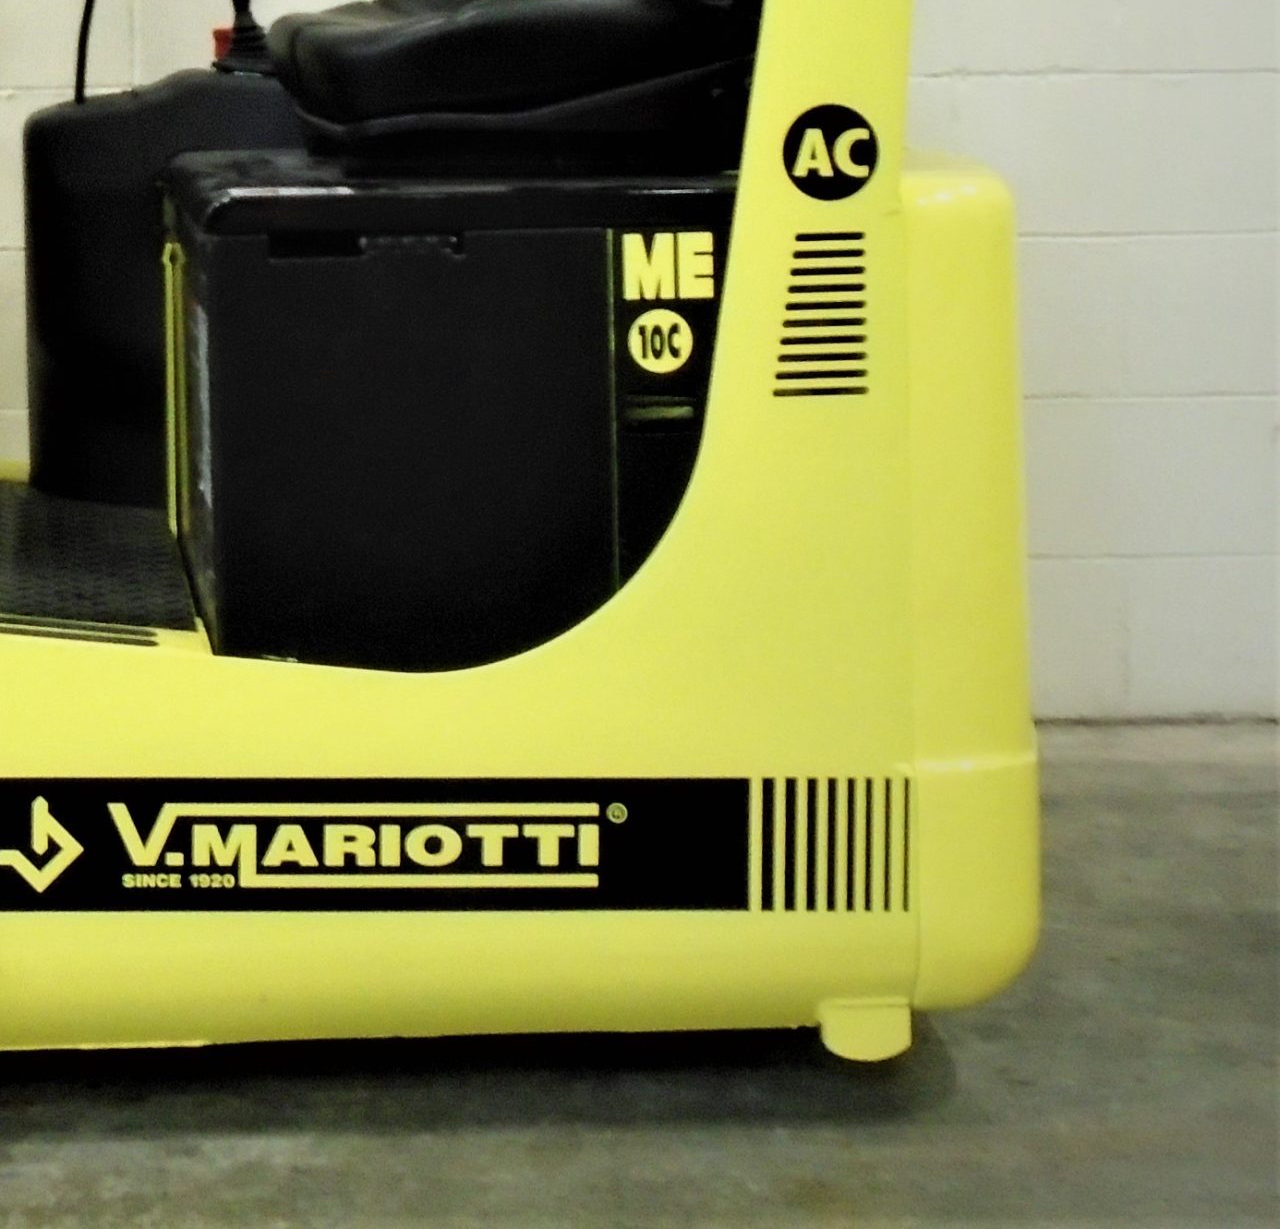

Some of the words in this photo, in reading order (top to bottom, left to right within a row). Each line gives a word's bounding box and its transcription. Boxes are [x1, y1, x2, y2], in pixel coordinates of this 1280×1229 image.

[792, 128, 870, 178] AC
[622, 231, 714, 301] ME
[638, 322, 682, 360] 10C
[107, 802, 600, 889] V.MARIOTTI
[122, 873, 182, 889] SINCE
[189, 873, 236, 889] 1920
